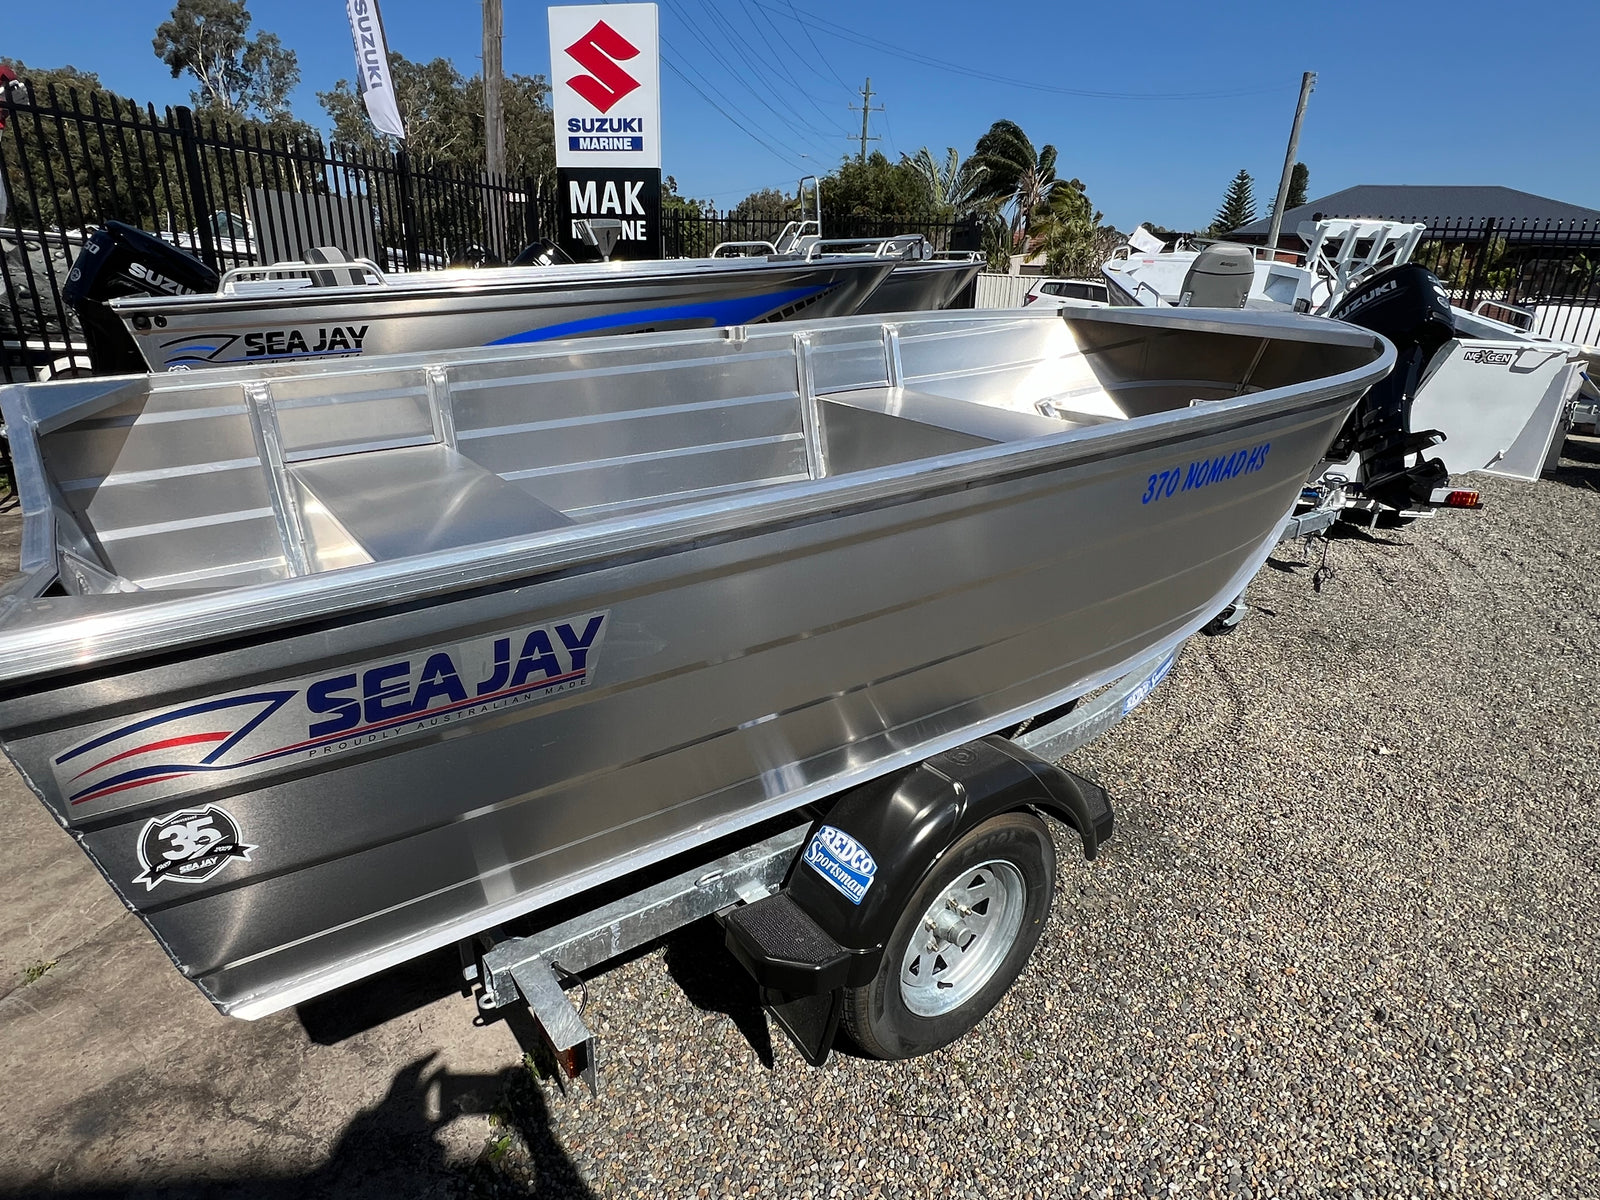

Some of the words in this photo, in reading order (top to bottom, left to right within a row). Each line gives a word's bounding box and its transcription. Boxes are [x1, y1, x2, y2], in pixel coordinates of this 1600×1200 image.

[354, 0, 383, 89] SUZUKI
[567, 117, 643, 133] SUZUKI
[579, 137, 632, 150] MARINE
[569, 181, 646, 215] MAK
[128, 262, 197, 296] SUZU
[1334, 280, 1397, 320] UZUKI
[244, 329, 309, 356] SEA
[312, 325, 369, 351] JAY
[1142, 467, 1181, 505] 370
[1181, 450, 1248, 492] NOMAD
[1245, 443, 1271, 475] HS
[306, 652, 469, 738] SEA
[476, 615, 605, 697] JAY
[309, 727, 402, 758] PROUDLY
[416, 693, 532, 730] AUSTRALIAN
[545, 678, 587, 695] MADE
[158, 816, 222, 861] 35
[820, 828, 873, 873] REDCO
[179, 863, 200, 874] SEA
[200, 856, 218, 868] JAY
[806, 841, 865, 897] Sportsman
